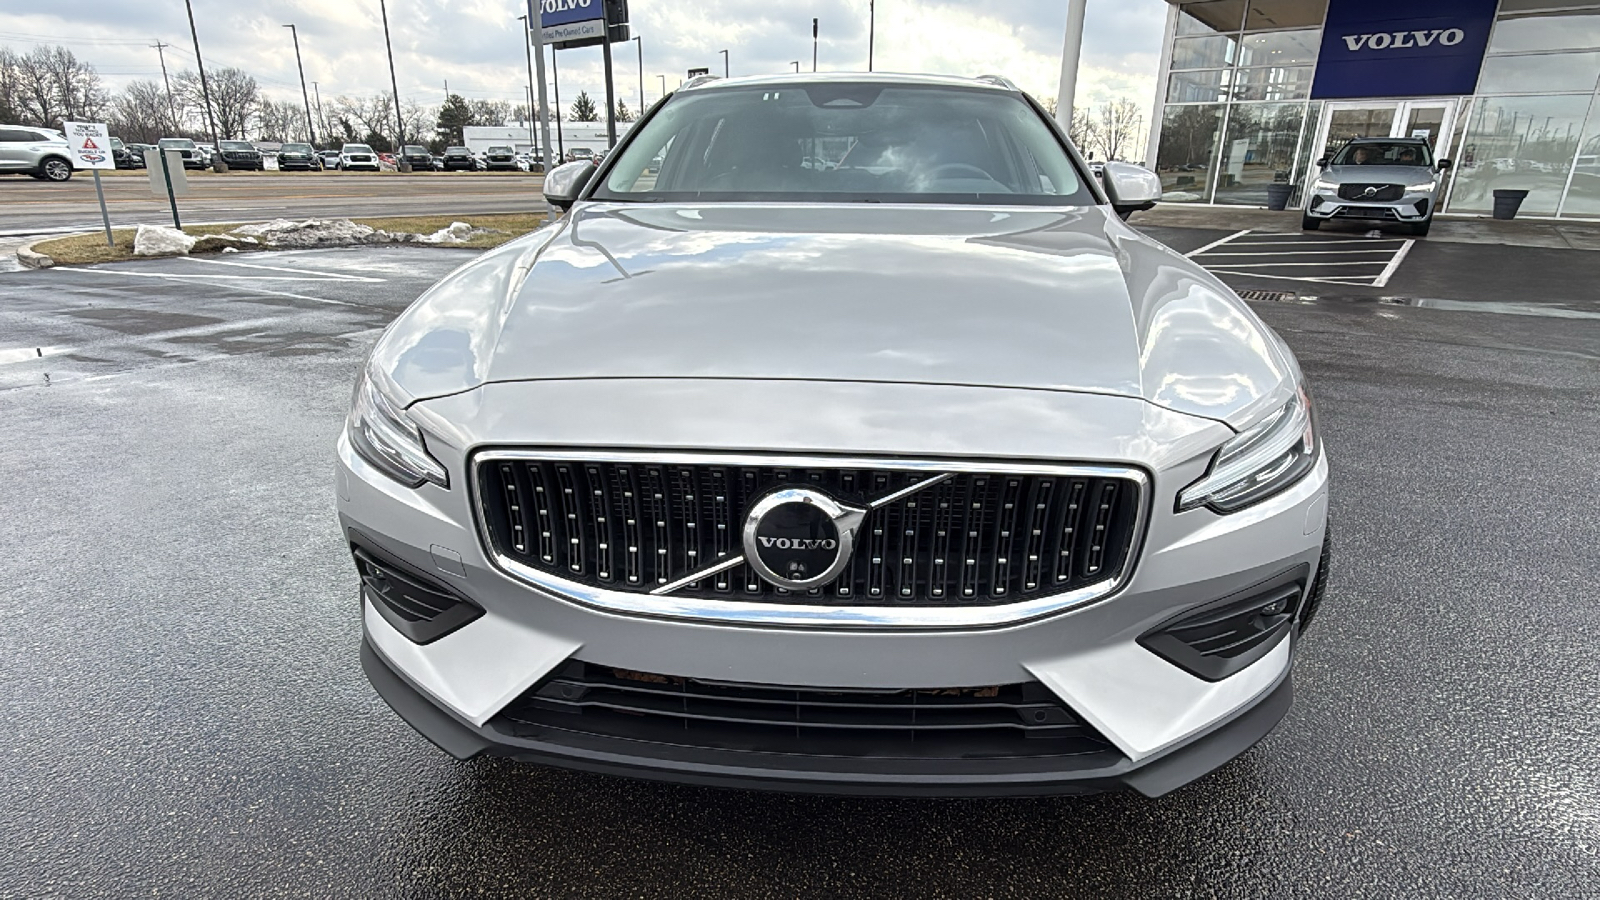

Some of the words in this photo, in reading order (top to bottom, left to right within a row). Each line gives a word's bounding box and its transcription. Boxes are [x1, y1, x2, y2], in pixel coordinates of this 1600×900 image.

[582, 25, 594, 34] Cars
[1342, 28, 1465, 51] VOLVO
[758, 536, 836, 550] VOLVO
